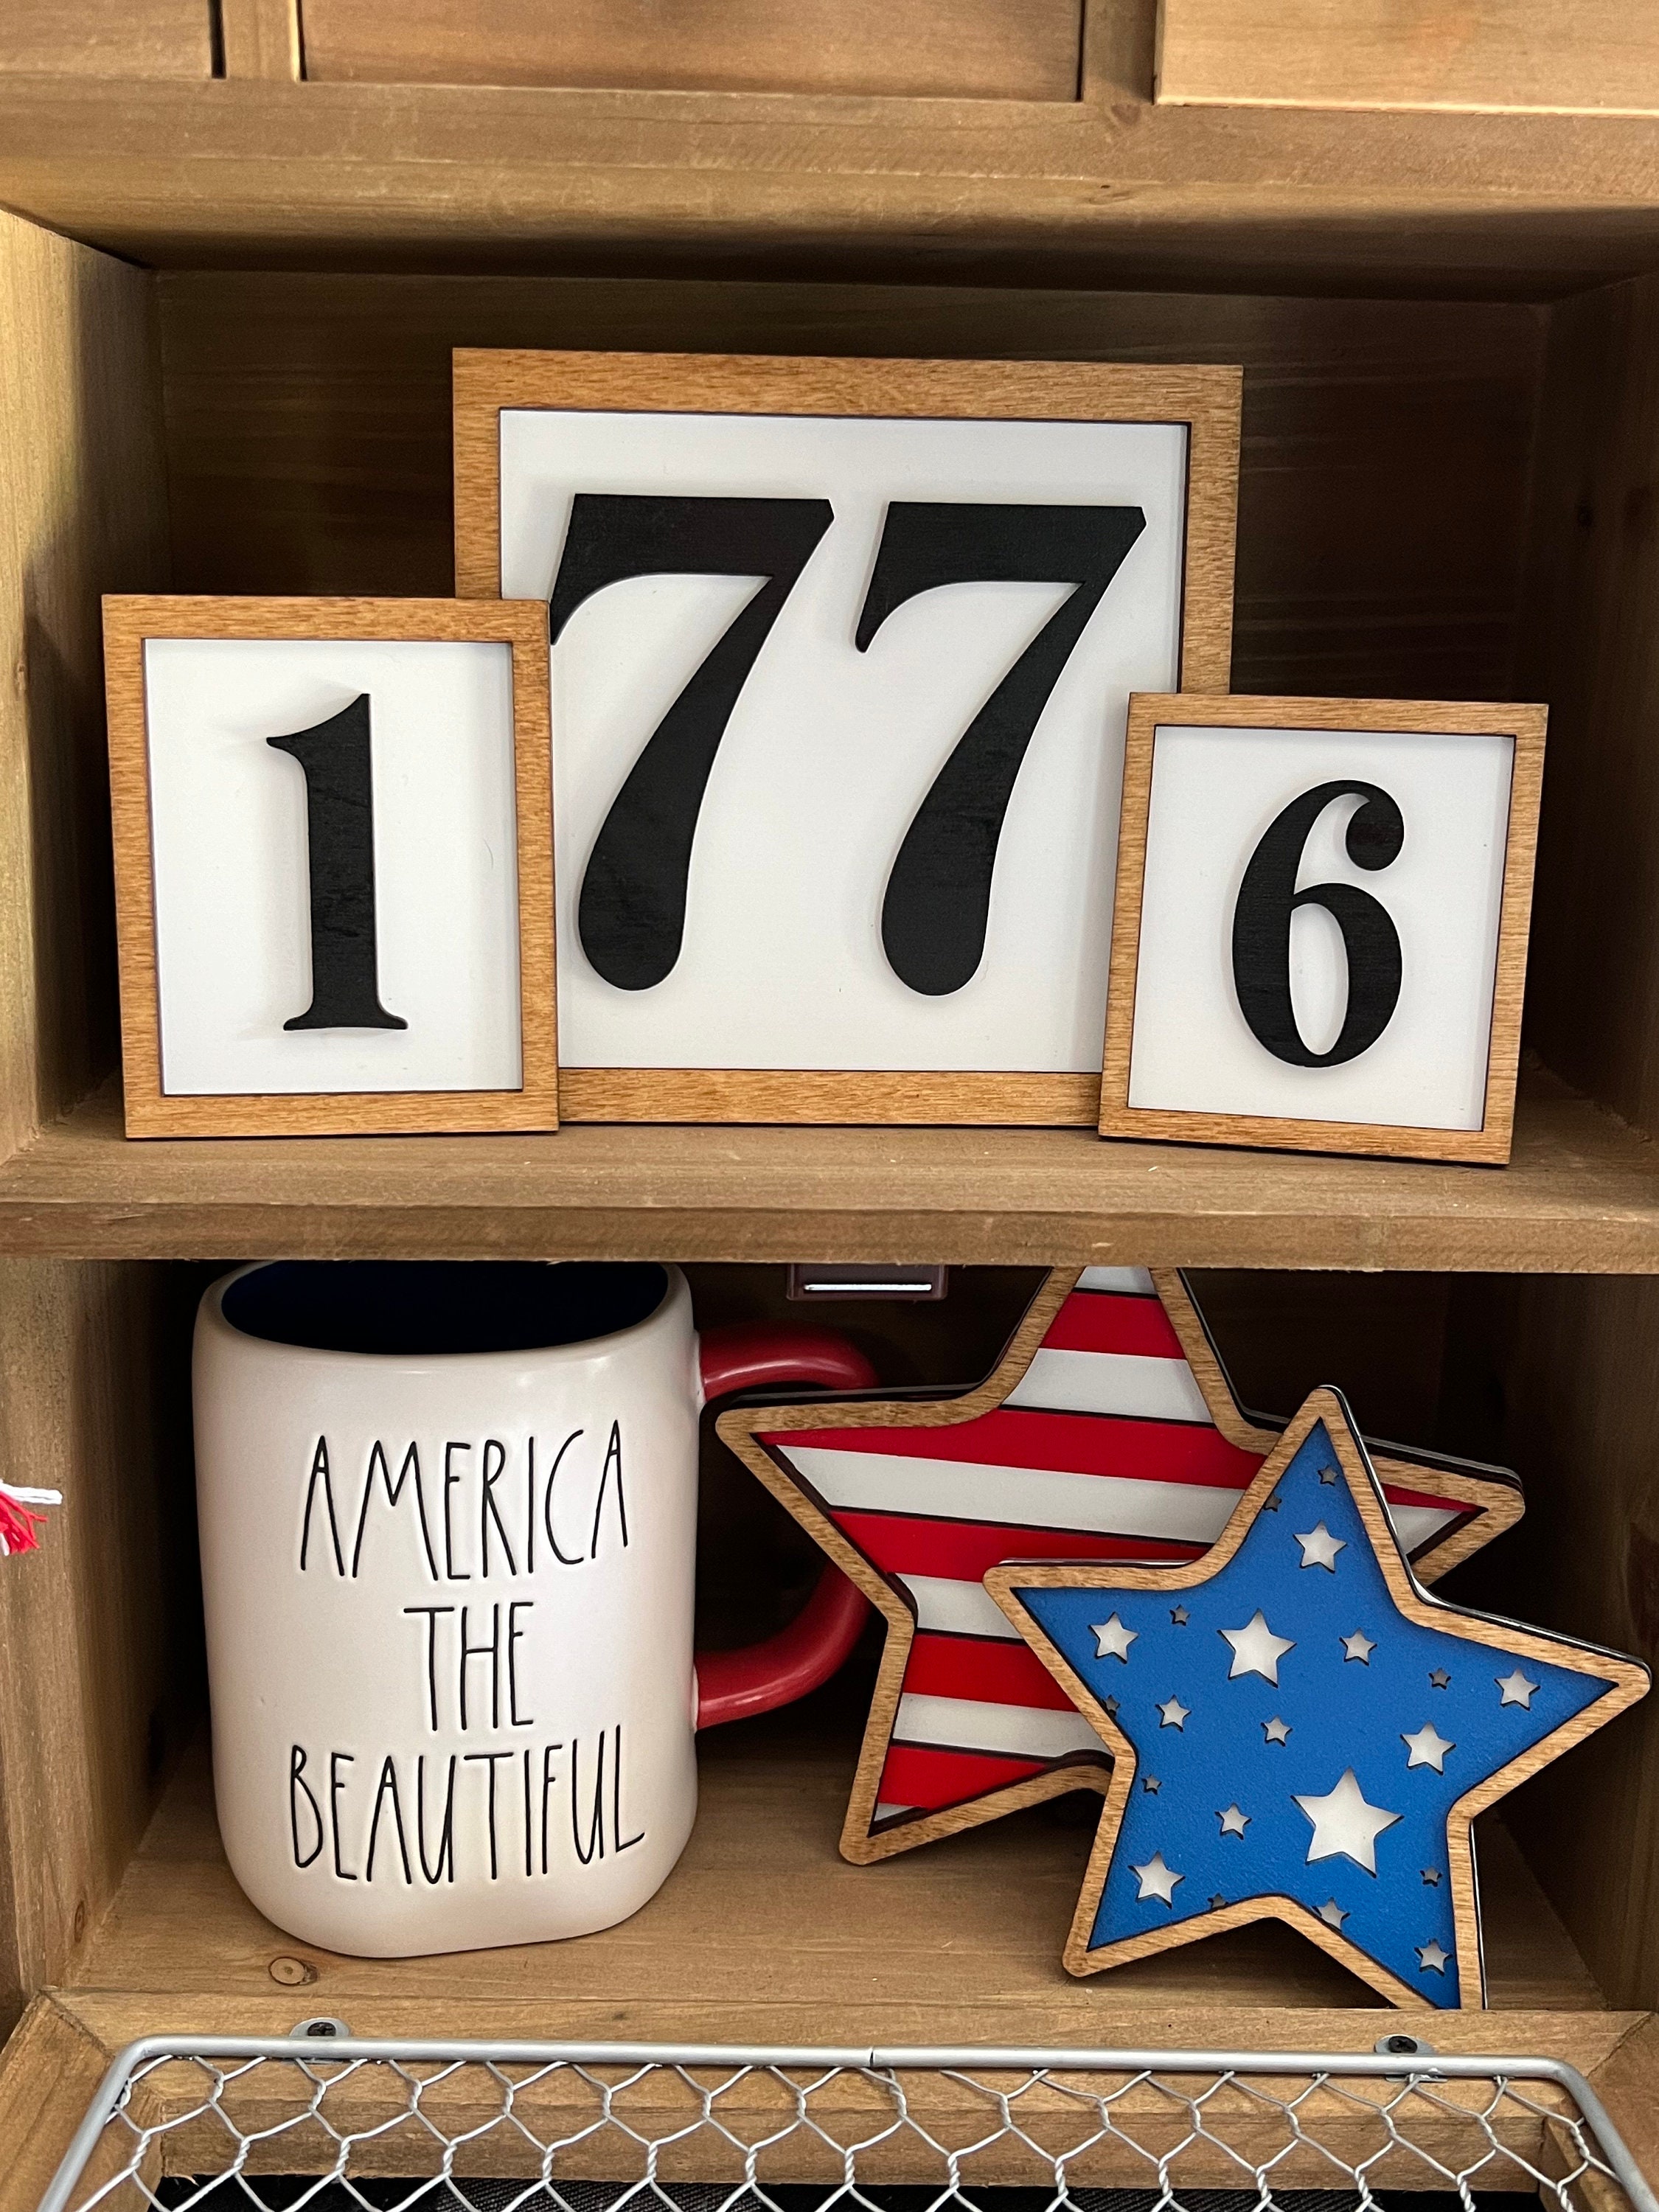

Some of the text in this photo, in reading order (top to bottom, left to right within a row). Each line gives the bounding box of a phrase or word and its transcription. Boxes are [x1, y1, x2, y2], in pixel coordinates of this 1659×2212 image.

[551, 493, 1147, 996] 77
[266, 693, 408, 1032] 1
[1232, 780, 1405, 1068] 6
[299, 1419, 629, 1581] AMERICA
[403, 1601, 535, 1732] THE
[290, 1724, 645, 1885] BEAUTIFUL
